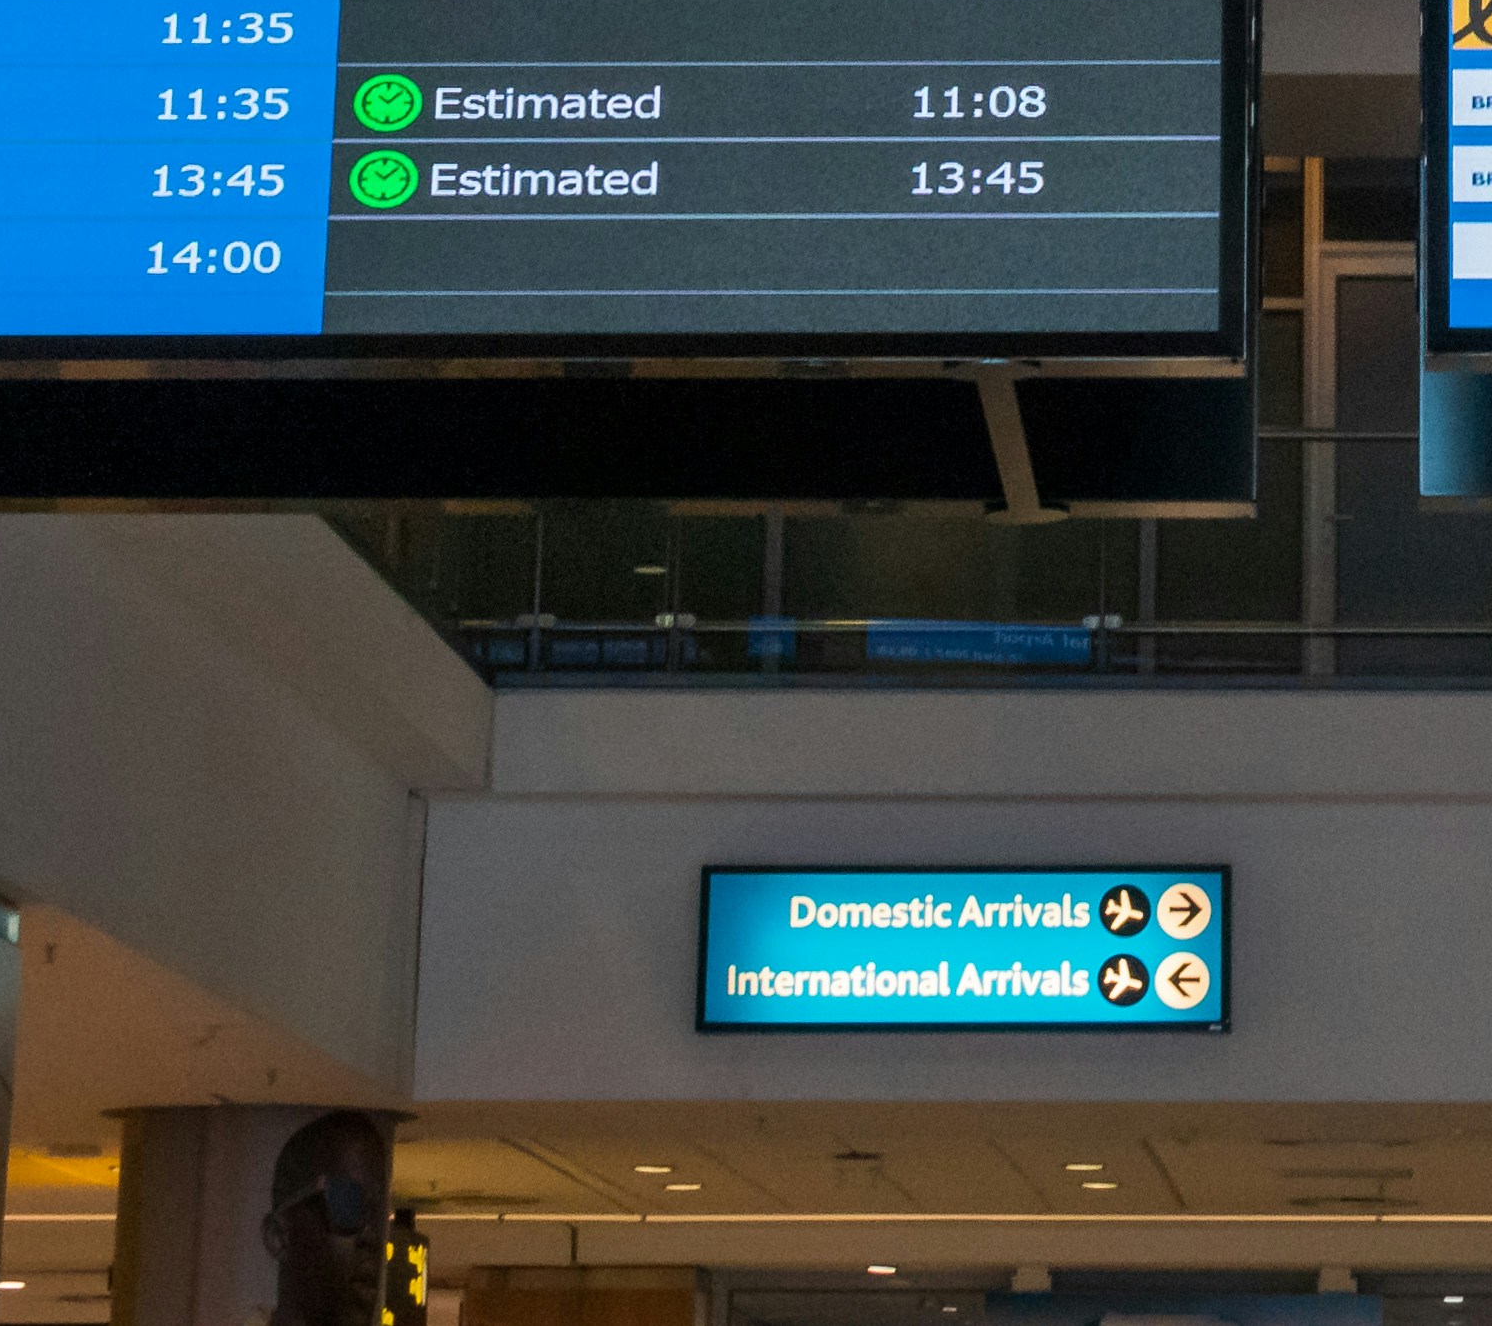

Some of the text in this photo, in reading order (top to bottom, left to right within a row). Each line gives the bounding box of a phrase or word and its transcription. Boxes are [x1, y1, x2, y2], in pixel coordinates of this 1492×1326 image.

[159, 89, 288, 119] 11:35
[435, 85, 661, 119] Estimated
[914, 86, 1046, 118] 11:08
[789, 894, 1090, 928] Domestic Arrivals
[727, 961, 1090, 998] International Arrivals
